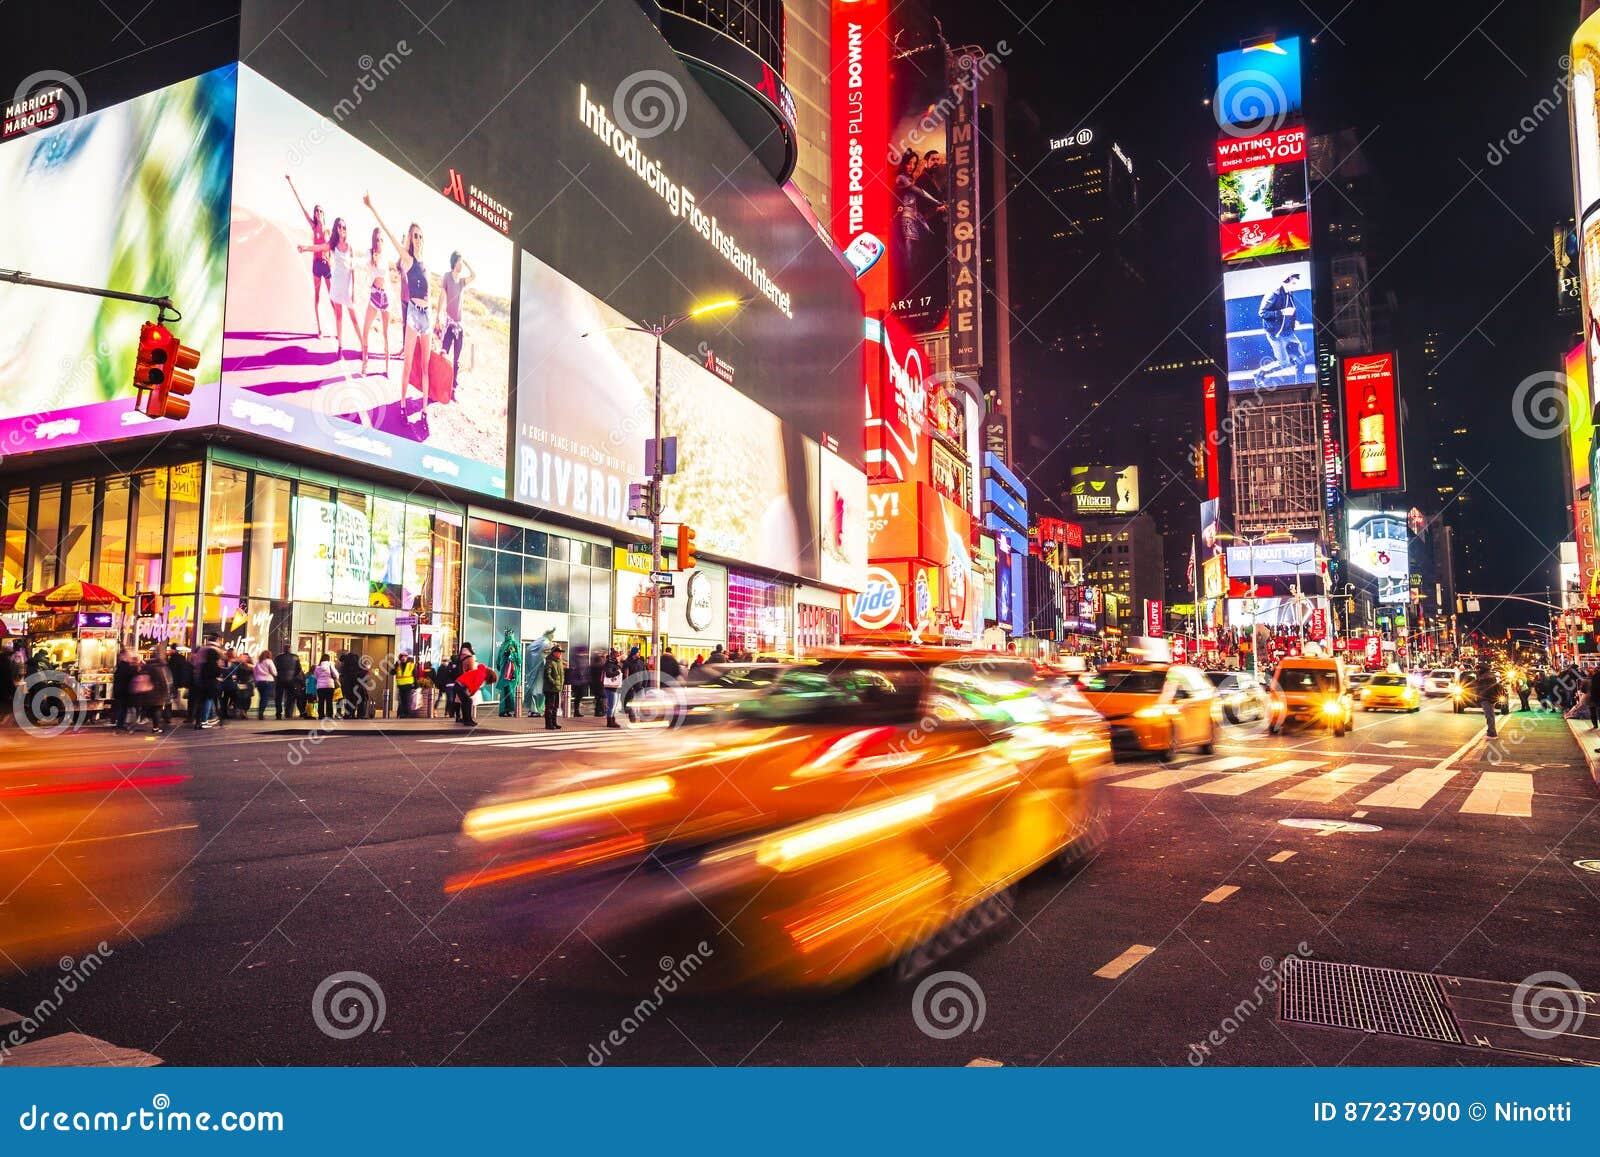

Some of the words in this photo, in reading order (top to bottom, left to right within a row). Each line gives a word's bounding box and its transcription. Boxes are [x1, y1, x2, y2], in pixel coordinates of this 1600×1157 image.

[848, 22, 863, 89] DOWNY
[5, 88, 64, 119] MARRIOTT
[848, 92, 863, 134] PLUS
[4, 107, 57, 135] MARQUIS
[1218, 137, 1272, 155] WAITING
[1278, 132, 1305, 145] FOR
[1266, 142, 1302, 159] YOU
[1245, 154, 1267, 163] CHINA
[579, 83, 680, 217] Introducing
[681, 184, 711, 241] Fios
[711, 215, 754, 281] Instant
[469, 198, 509, 232] MARQUIS
[470, 185, 513, 220] MARRIOTT
[848, 194, 863, 235] TIDE
[953, 200, 975, 332] SQUARE
[920, 296, 932, 307] 17
[550, 433, 569, 452] PLACE
[570, 441, 578, 455] TO
[1254, 547, 1281, 559] ABOUT
[326, 611, 370, 626] swatch
